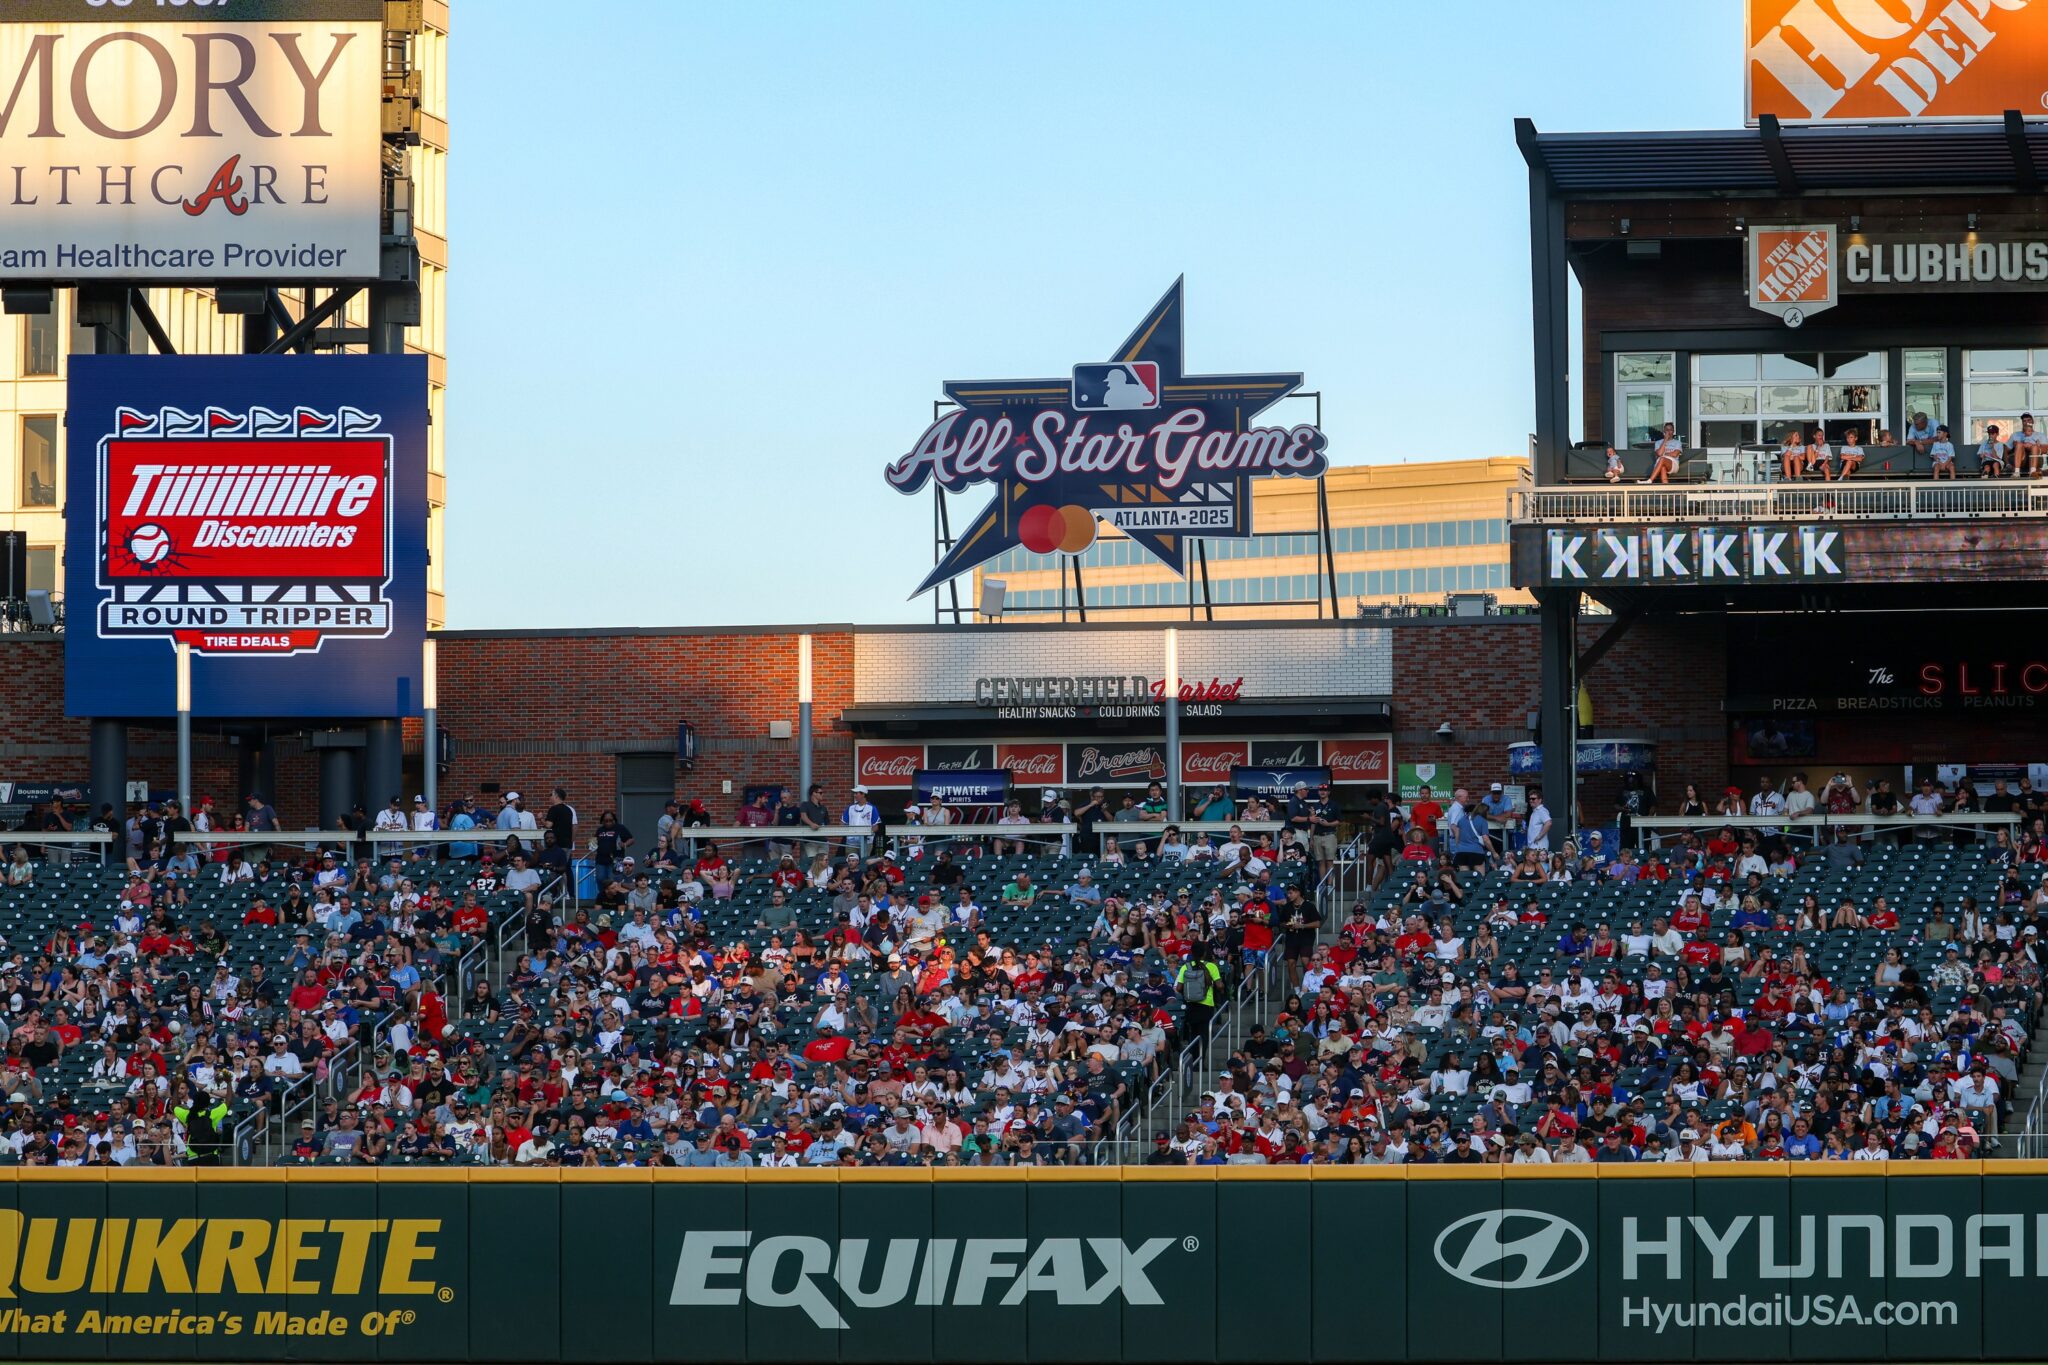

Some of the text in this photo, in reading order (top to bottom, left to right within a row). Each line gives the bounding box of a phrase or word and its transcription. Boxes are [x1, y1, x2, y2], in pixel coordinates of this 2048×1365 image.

[0, 243, 347, 268] am Healthcare Provider
[1758, 231, 1828, 302] HOME
[1764, 238, 1795, 268] THE
[1847, 242, 2048, 283] CLUBHOUS
[1785, 257, 1829, 302] DEPOT
[888, 408, 1319, 488] All Star Game
[1114, 509, 1229, 527] ATLANTA 2025
[192, 520, 357, 548] Discounters
[121, 607, 373, 625] ROUND TRIPPER
[204, 636, 290, 647] TIRE DEALS
[1868, 667, 1894, 684] The
[975, 676, 1243, 707] CENTERFIELD Market
[1773, 695, 2034, 710] PIZZA BREADSTICKS PEANUTS
[998, 705, 1222, 719] HEALTHY SNACKS COLD DRINKS SALADS
[1078, 747, 1151, 778] Braves
[1257, 786, 1295, 794] CUTWATE
[477, 878, 496, 890] 27
[1623, 1213, 2048, 1280] HYUNDAI
[76, 1308, 242, 1336] America's
[253, 1309, 347, 1336] Made
[1623, 1293, 1958, 1334] HyundaiUSA.com
